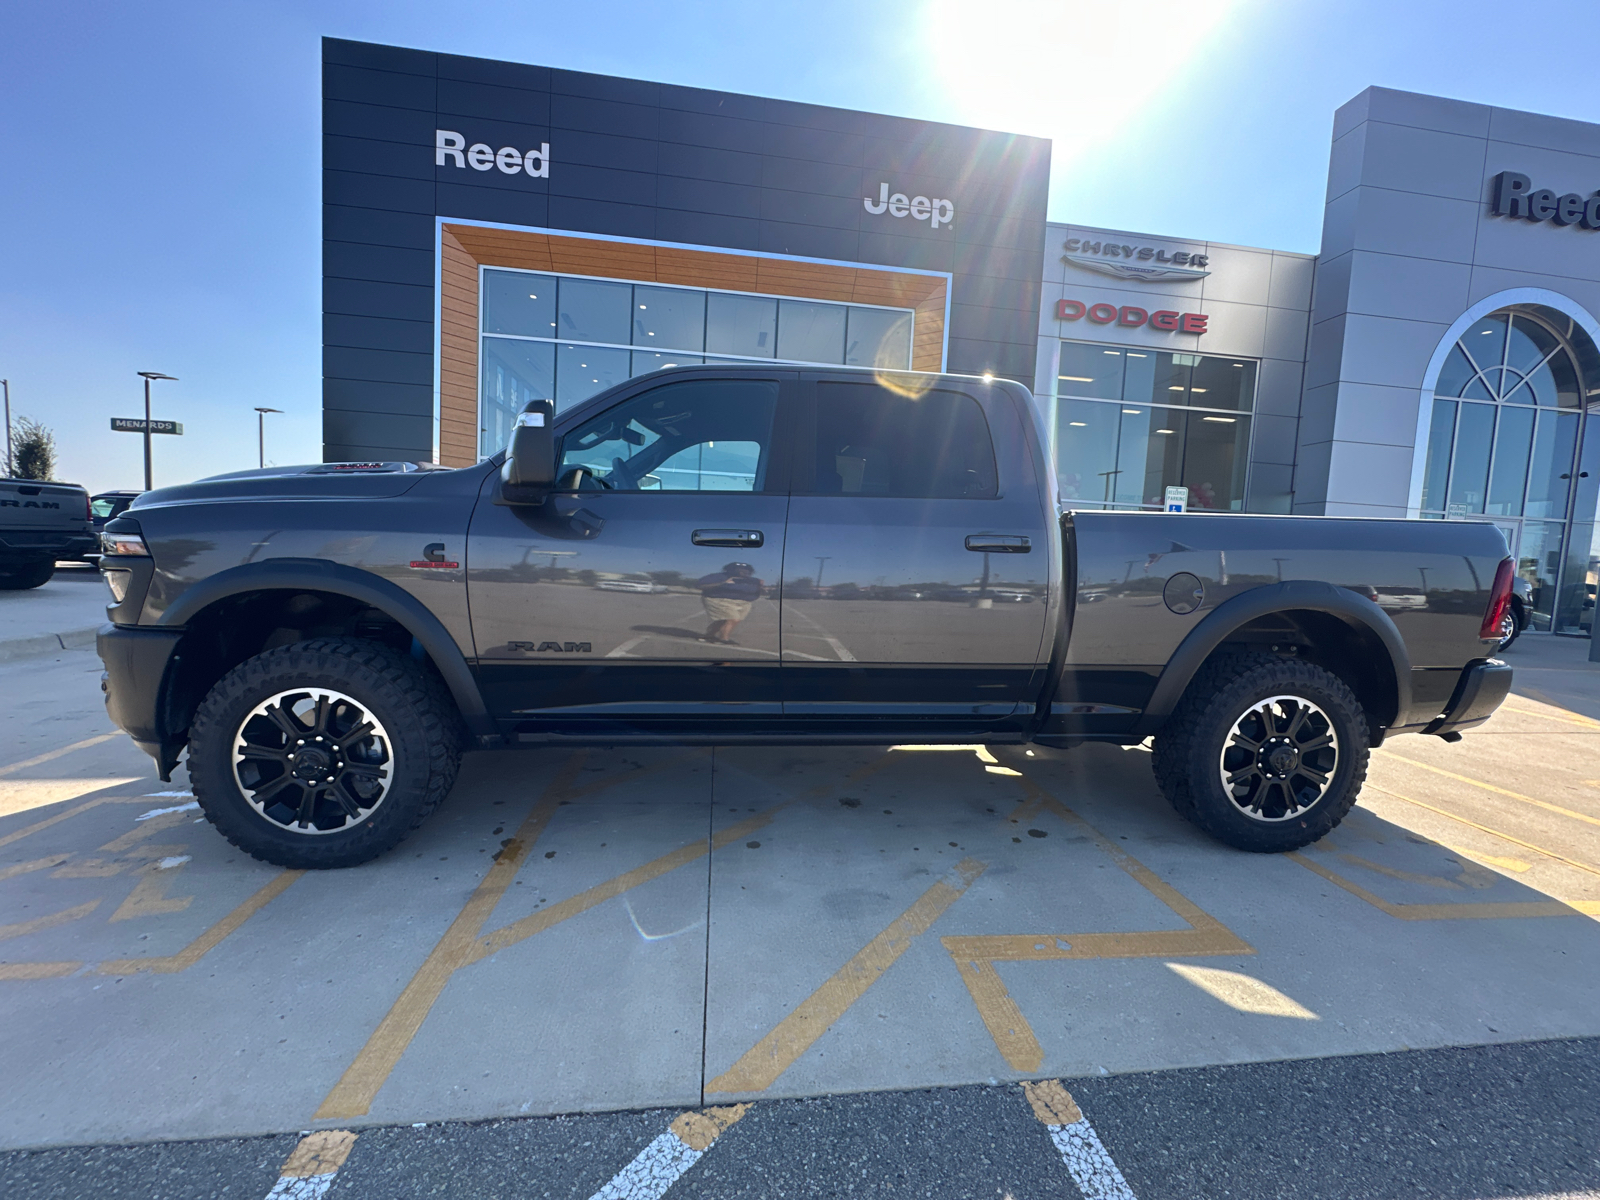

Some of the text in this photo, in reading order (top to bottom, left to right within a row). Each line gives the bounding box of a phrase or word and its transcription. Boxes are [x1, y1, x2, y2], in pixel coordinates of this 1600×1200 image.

[436, 129, 550, 179] Reed
[863, 182, 954, 229] Jeep
[1063, 238, 1209, 268] CHRYSLER
[1056, 299, 1209, 334] DODGE
[0, 499, 60, 510] RAM
[507, 641, 592, 653] RAM
